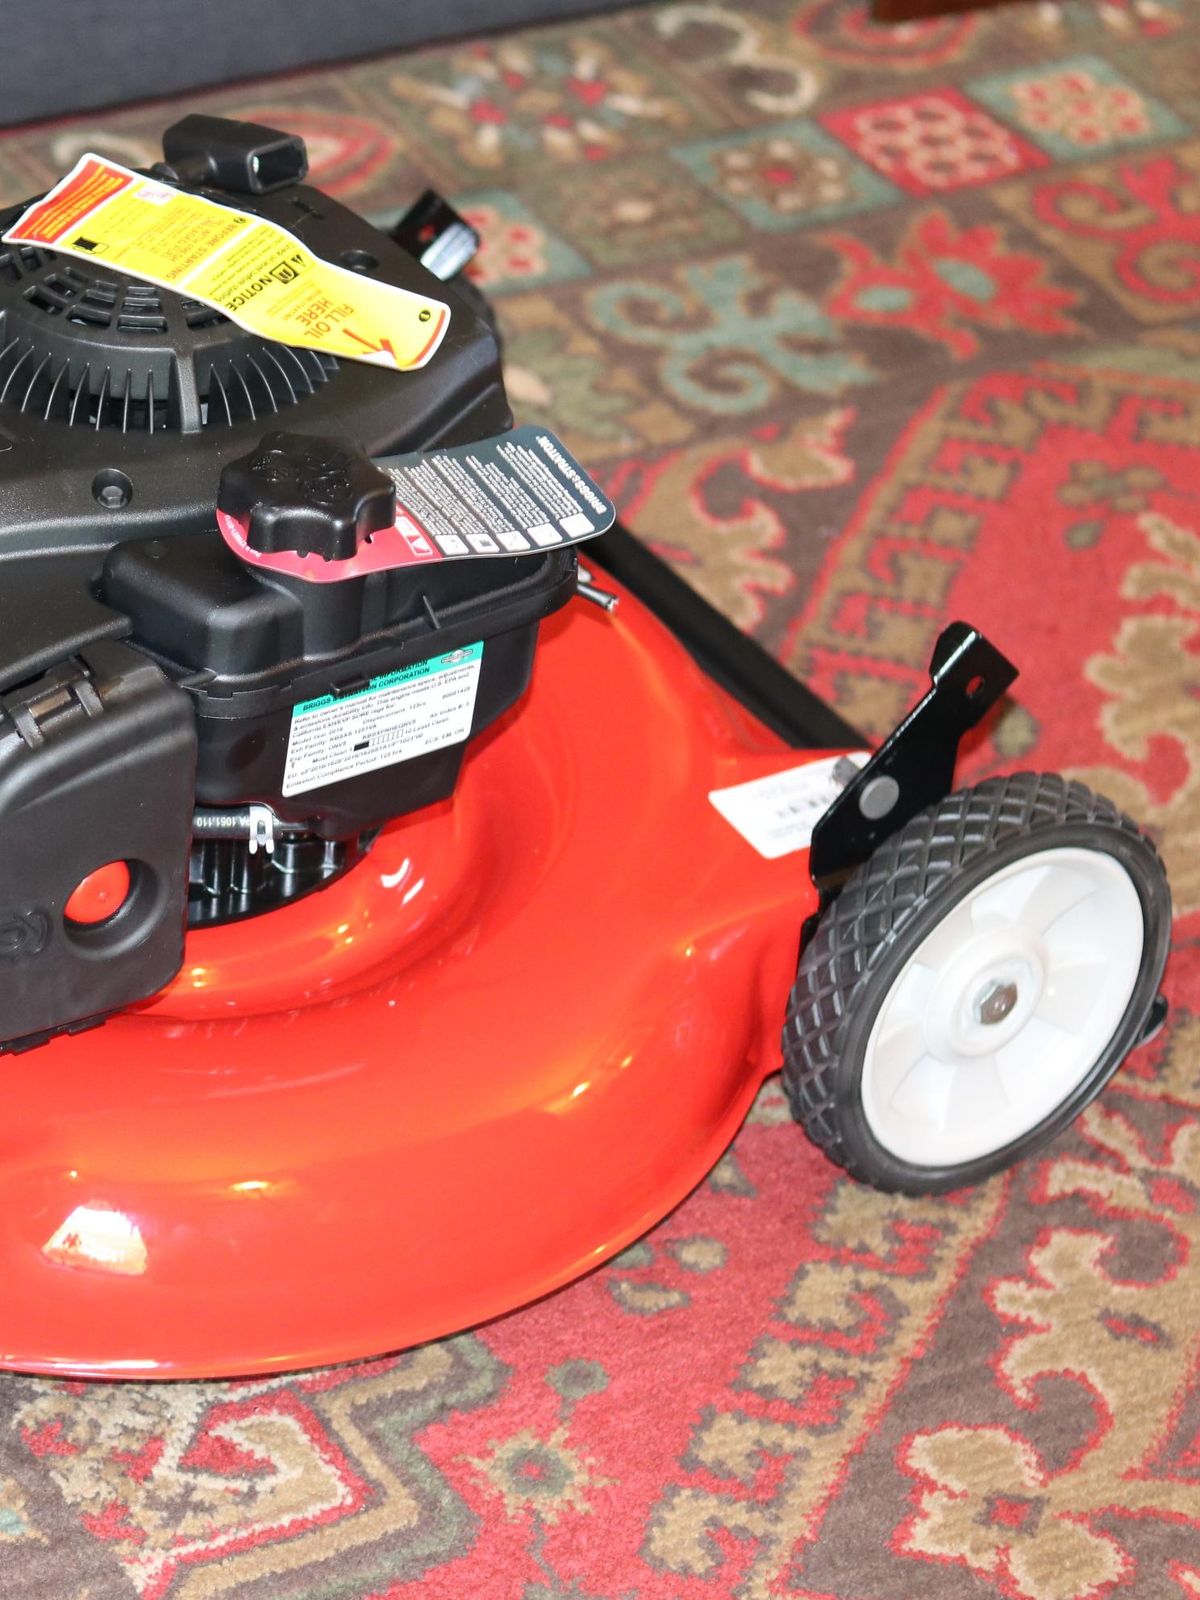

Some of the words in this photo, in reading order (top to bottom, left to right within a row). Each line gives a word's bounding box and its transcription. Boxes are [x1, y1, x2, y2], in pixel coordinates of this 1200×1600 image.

[166, 247, 209, 280] STARTING
[225, 274, 273, 312] NOTICE
[296, 298, 334, 326] HERE
[327, 303, 355, 322] FILL
[304, 321, 331, 339] OIL
[302, 697, 331, 711] BRIGGS
[378, 667, 430, 687] CORPORATION
